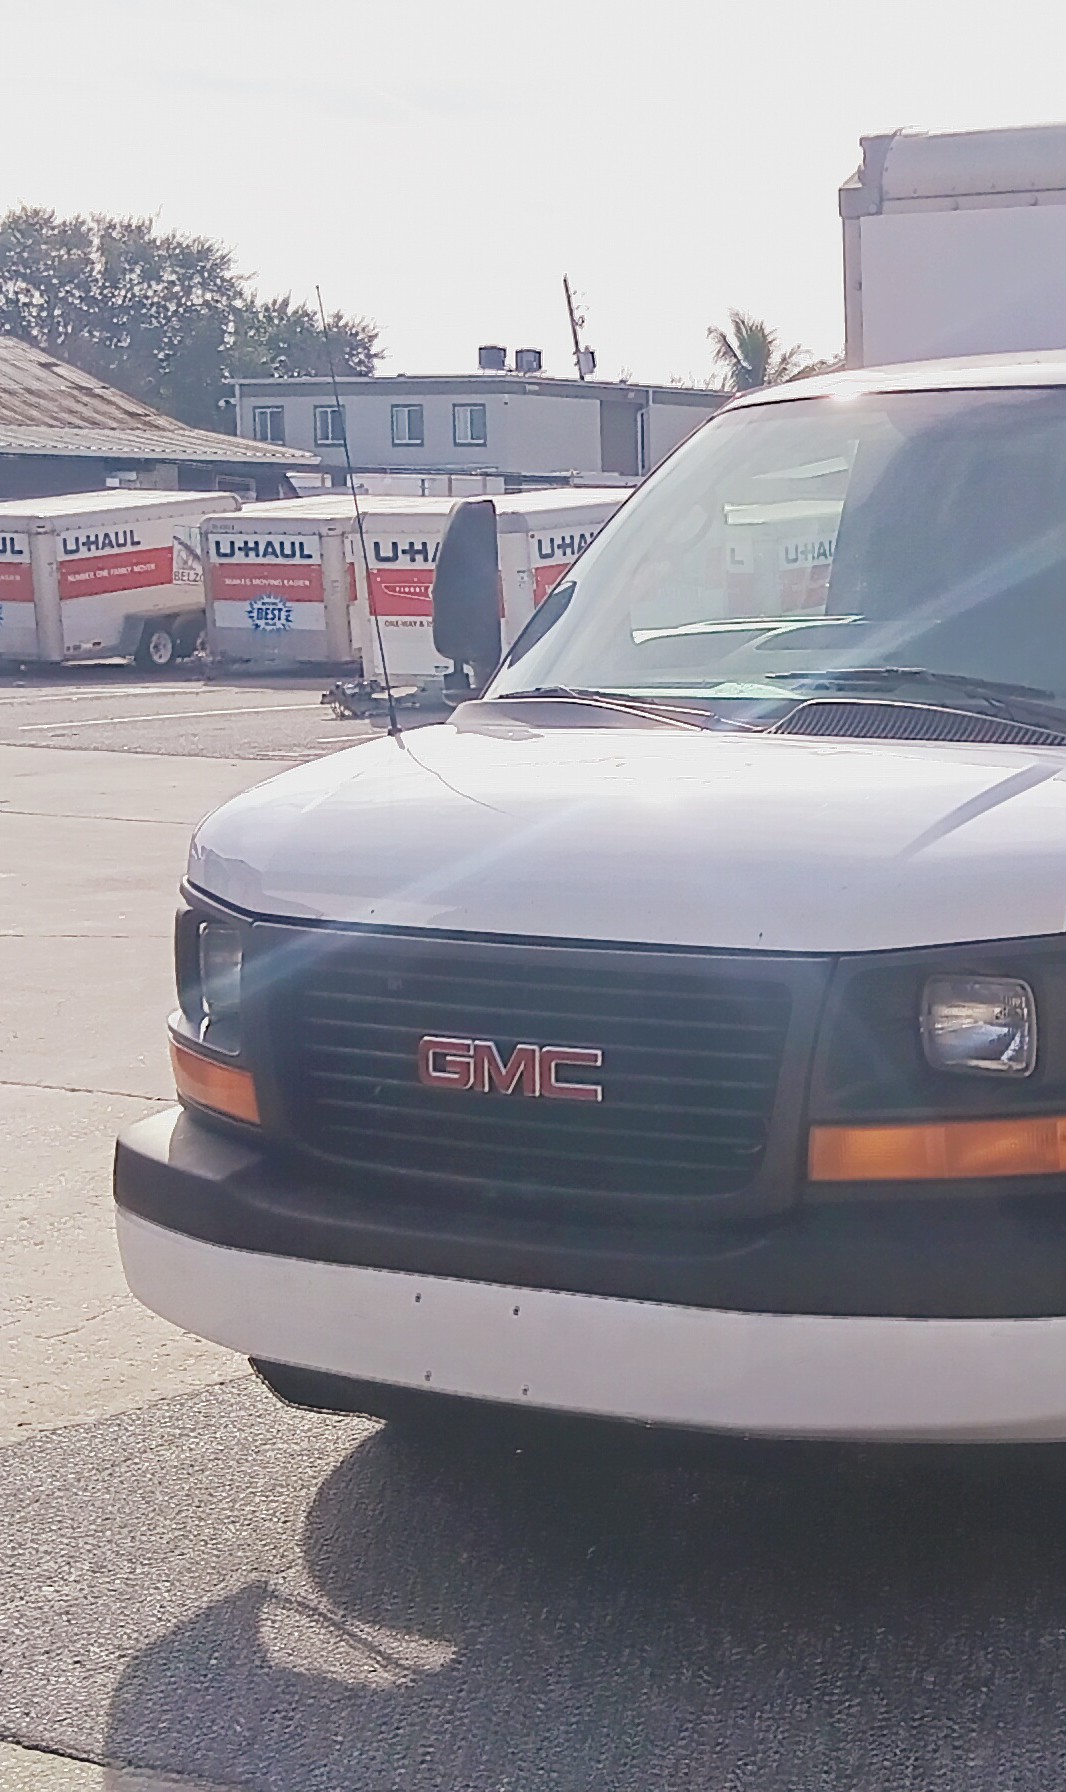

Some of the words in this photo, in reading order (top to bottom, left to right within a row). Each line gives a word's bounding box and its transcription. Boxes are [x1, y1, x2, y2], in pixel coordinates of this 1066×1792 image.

[62, 529, 141, 555] U-HAUL
[215, 540, 313, 559] U-HAUL
[256, 607, 283, 621] BEST
[418, 1035, 603, 1102] GMC
